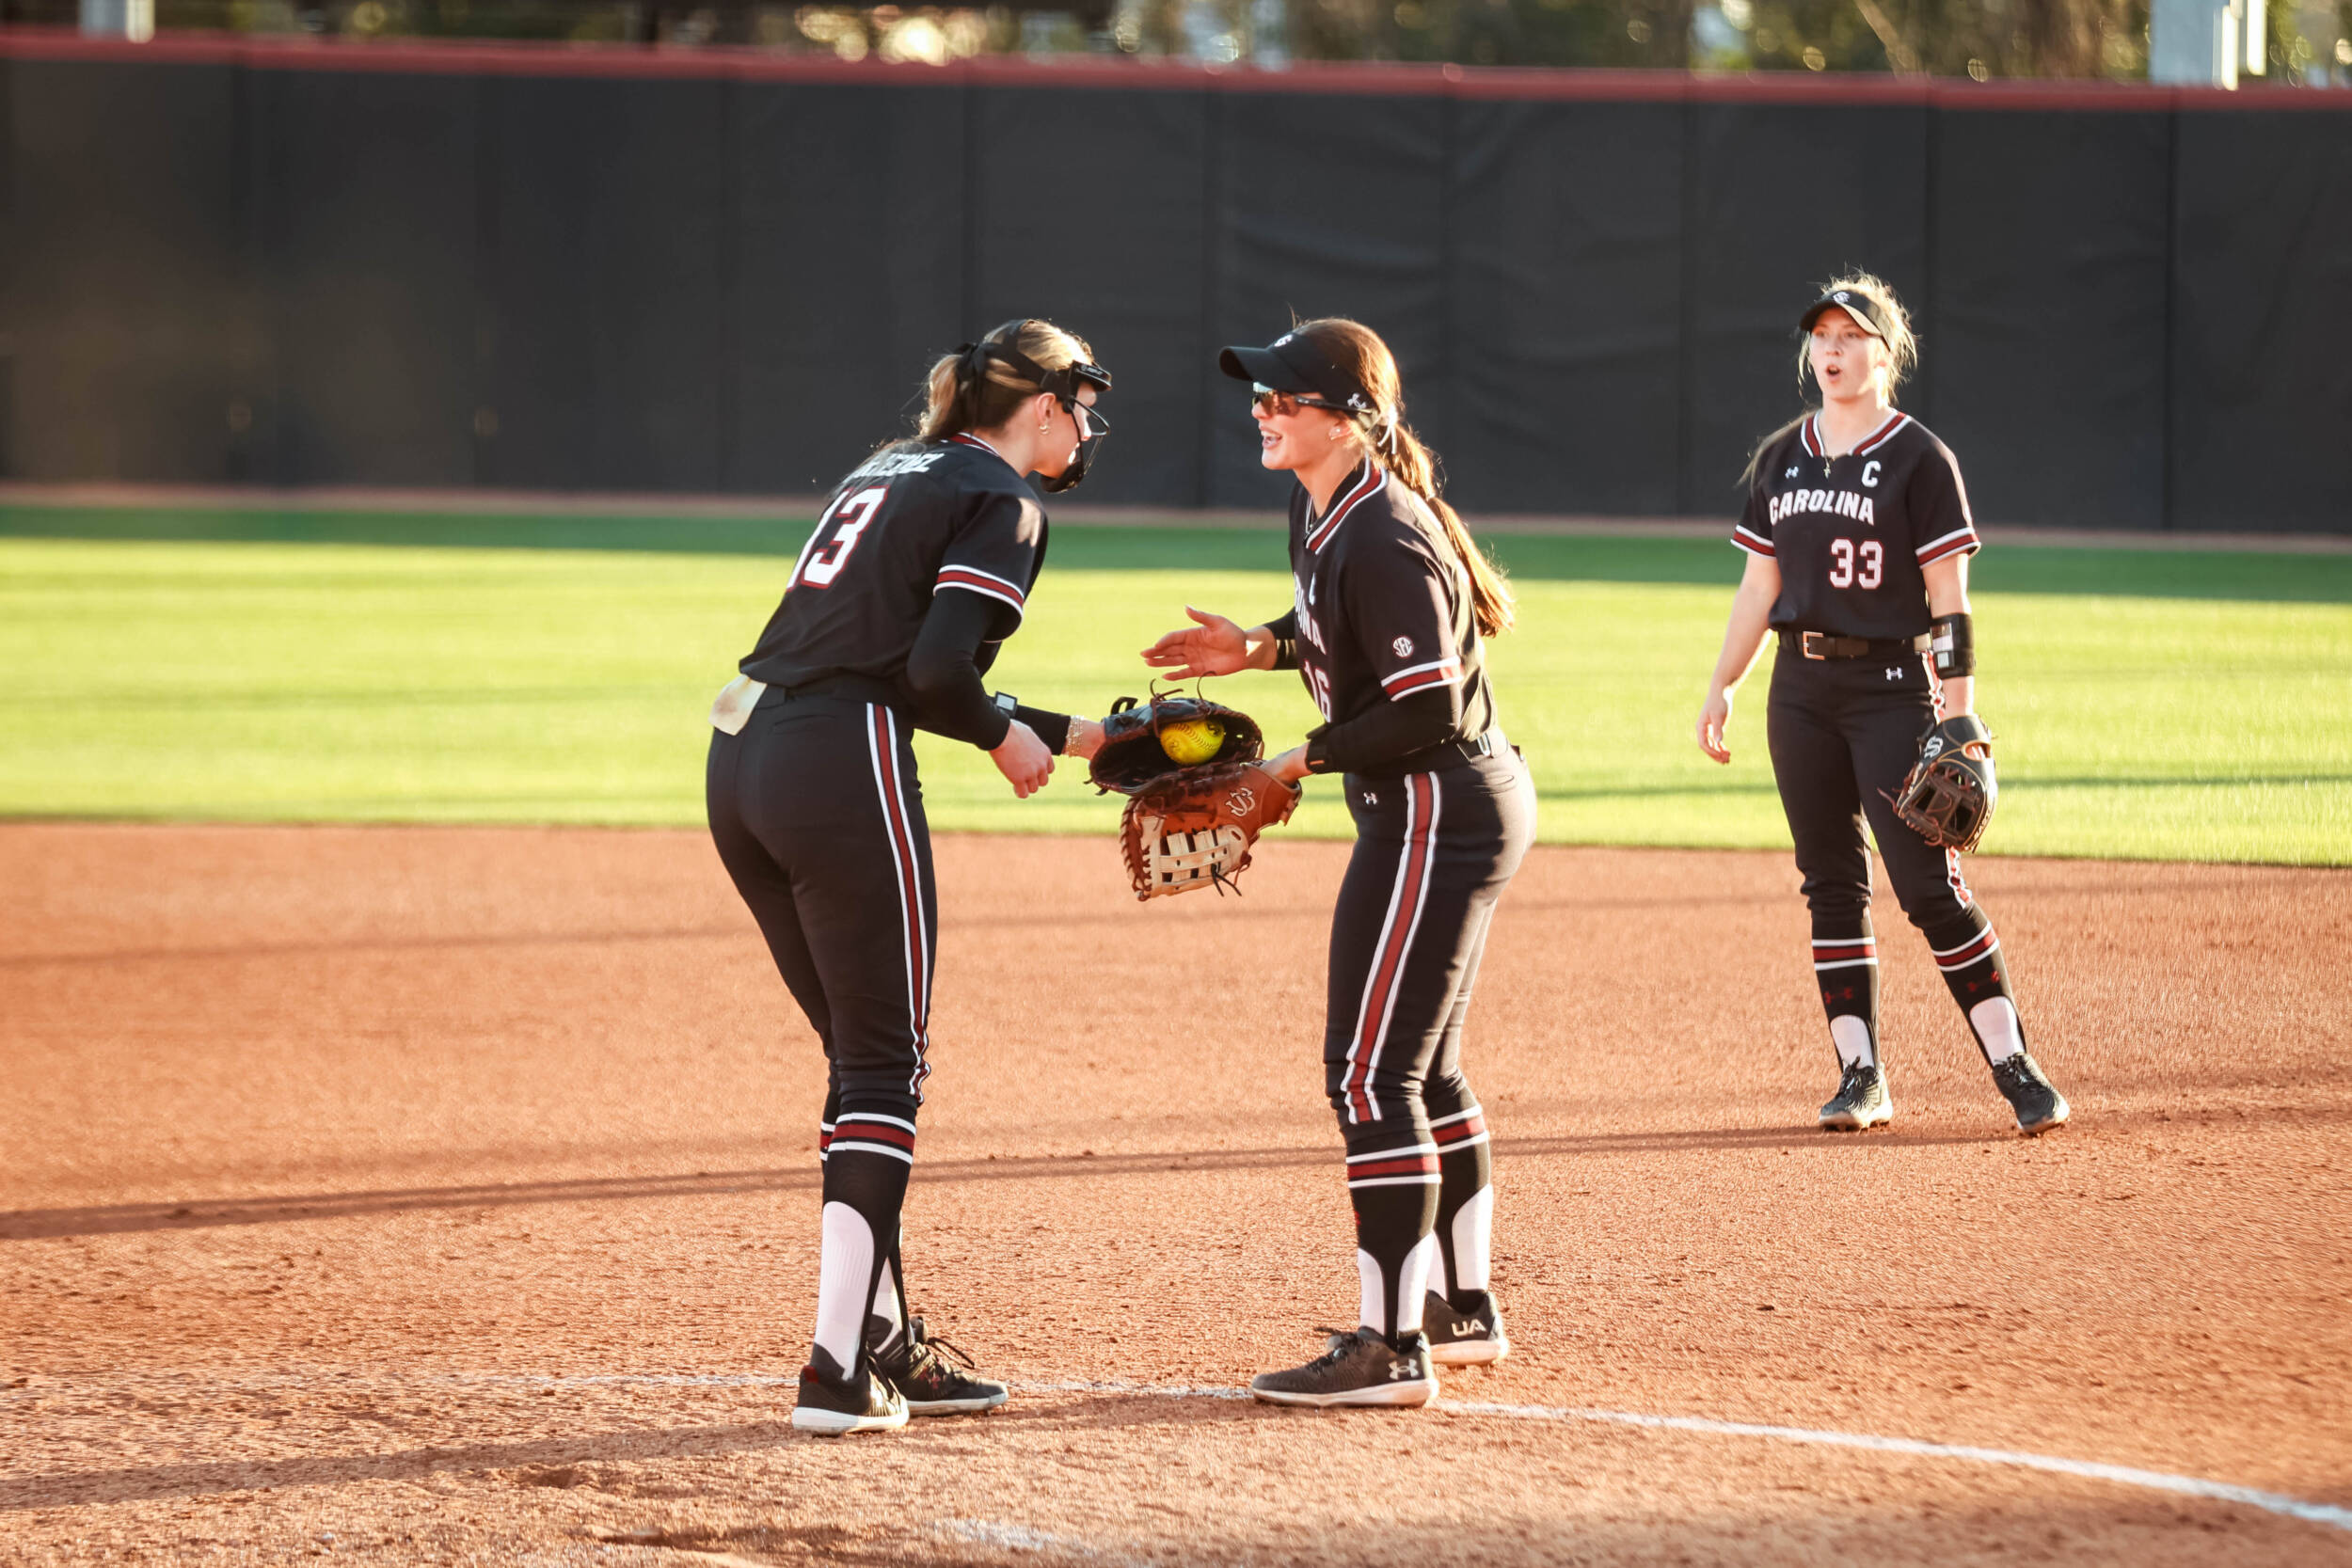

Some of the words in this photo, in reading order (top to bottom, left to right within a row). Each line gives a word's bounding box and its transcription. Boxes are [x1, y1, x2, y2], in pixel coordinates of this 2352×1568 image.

[1861, 461, 1882, 487] C
[1769, 488, 1875, 526] CAROLINA
[1829, 538, 1883, 590] 33
[1304, 659, 1331, 723] 16
[1451, 1318, 1487, 1337] UA
